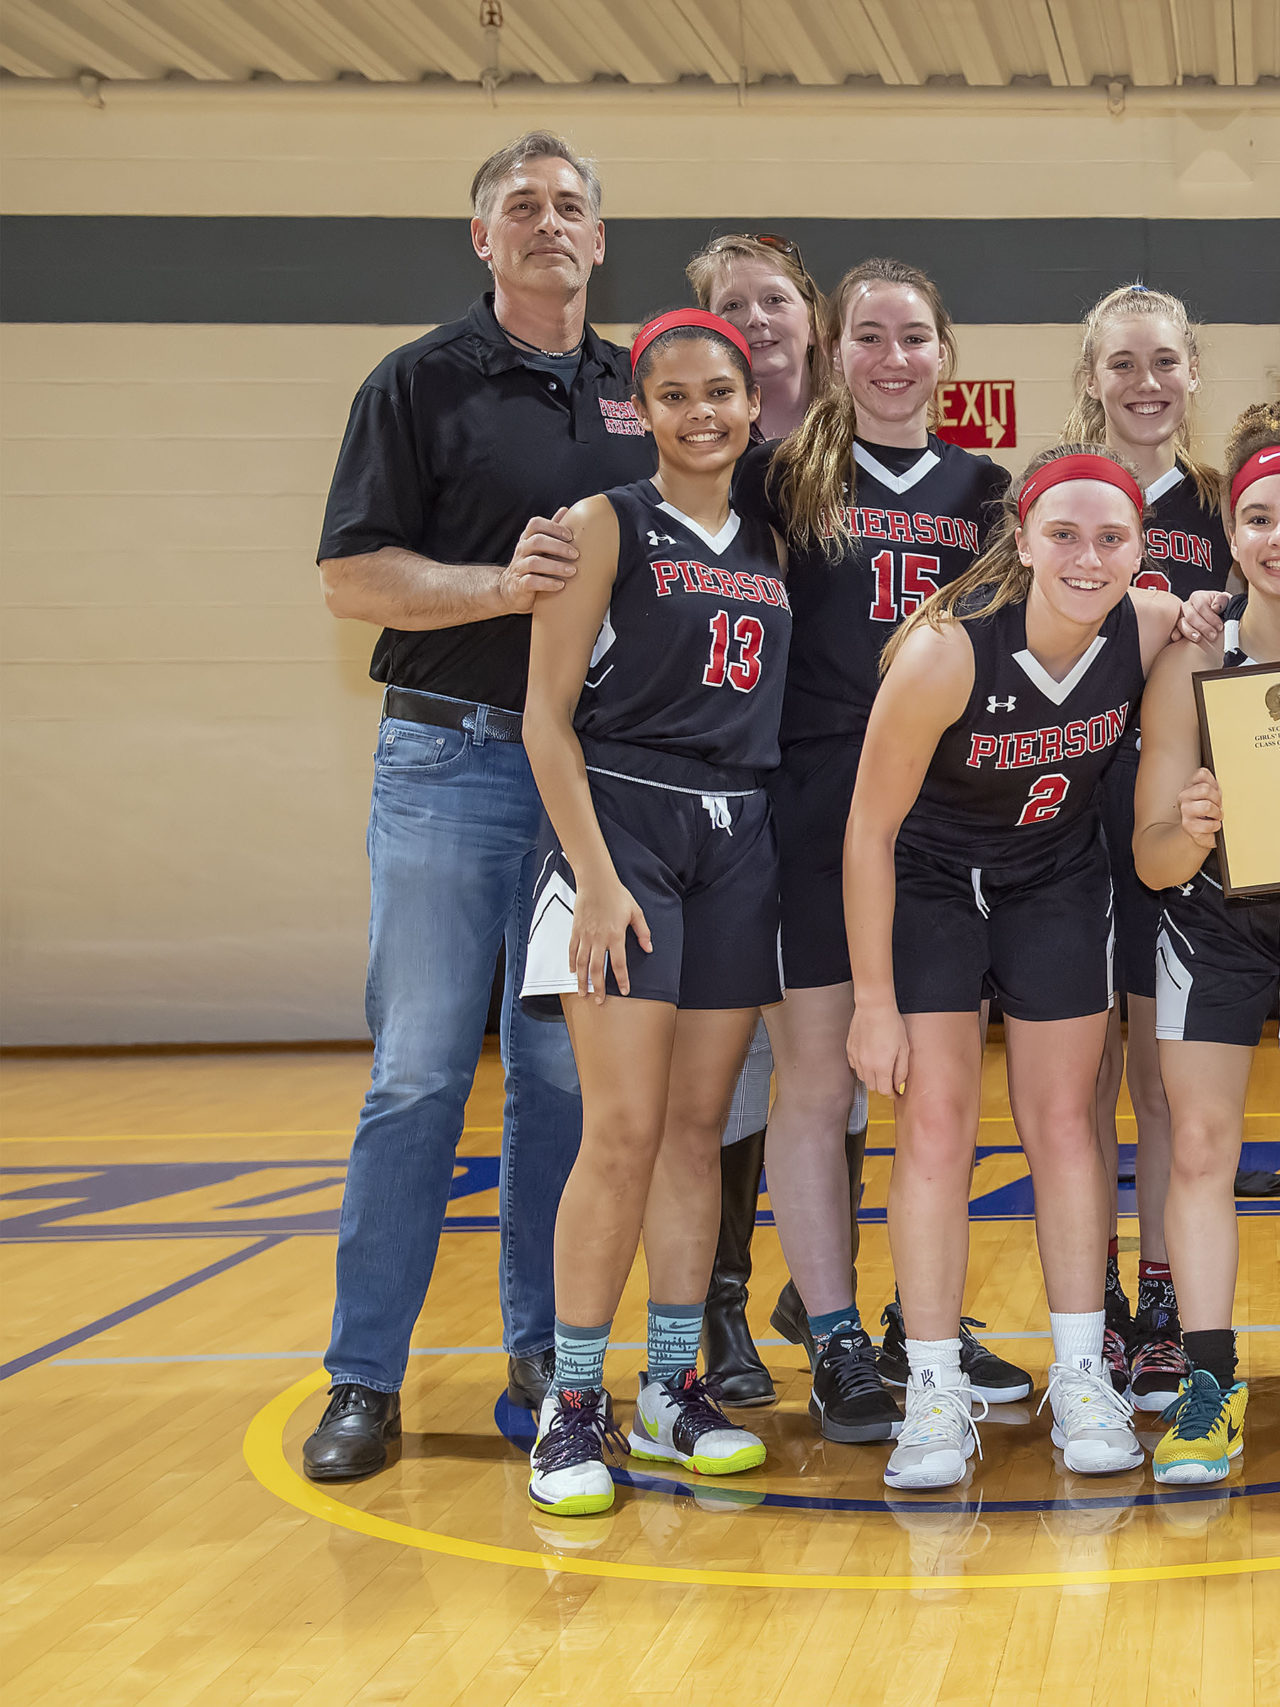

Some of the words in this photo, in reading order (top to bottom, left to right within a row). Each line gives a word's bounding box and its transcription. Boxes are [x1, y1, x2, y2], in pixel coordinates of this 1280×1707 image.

[937, 383, 1013, 427] EXIT
[821, 506, 980, 555] PIERSON
[650, 560, 793, 617] PIERSON
[869, 550, 941, 622] 15
[702, 609, 765, 694] 13
[966, 701, 1129, 770] PIERSON
[1254, 741, 1276, 749] CLASS
[1014, 773, 1070, 826] 2
